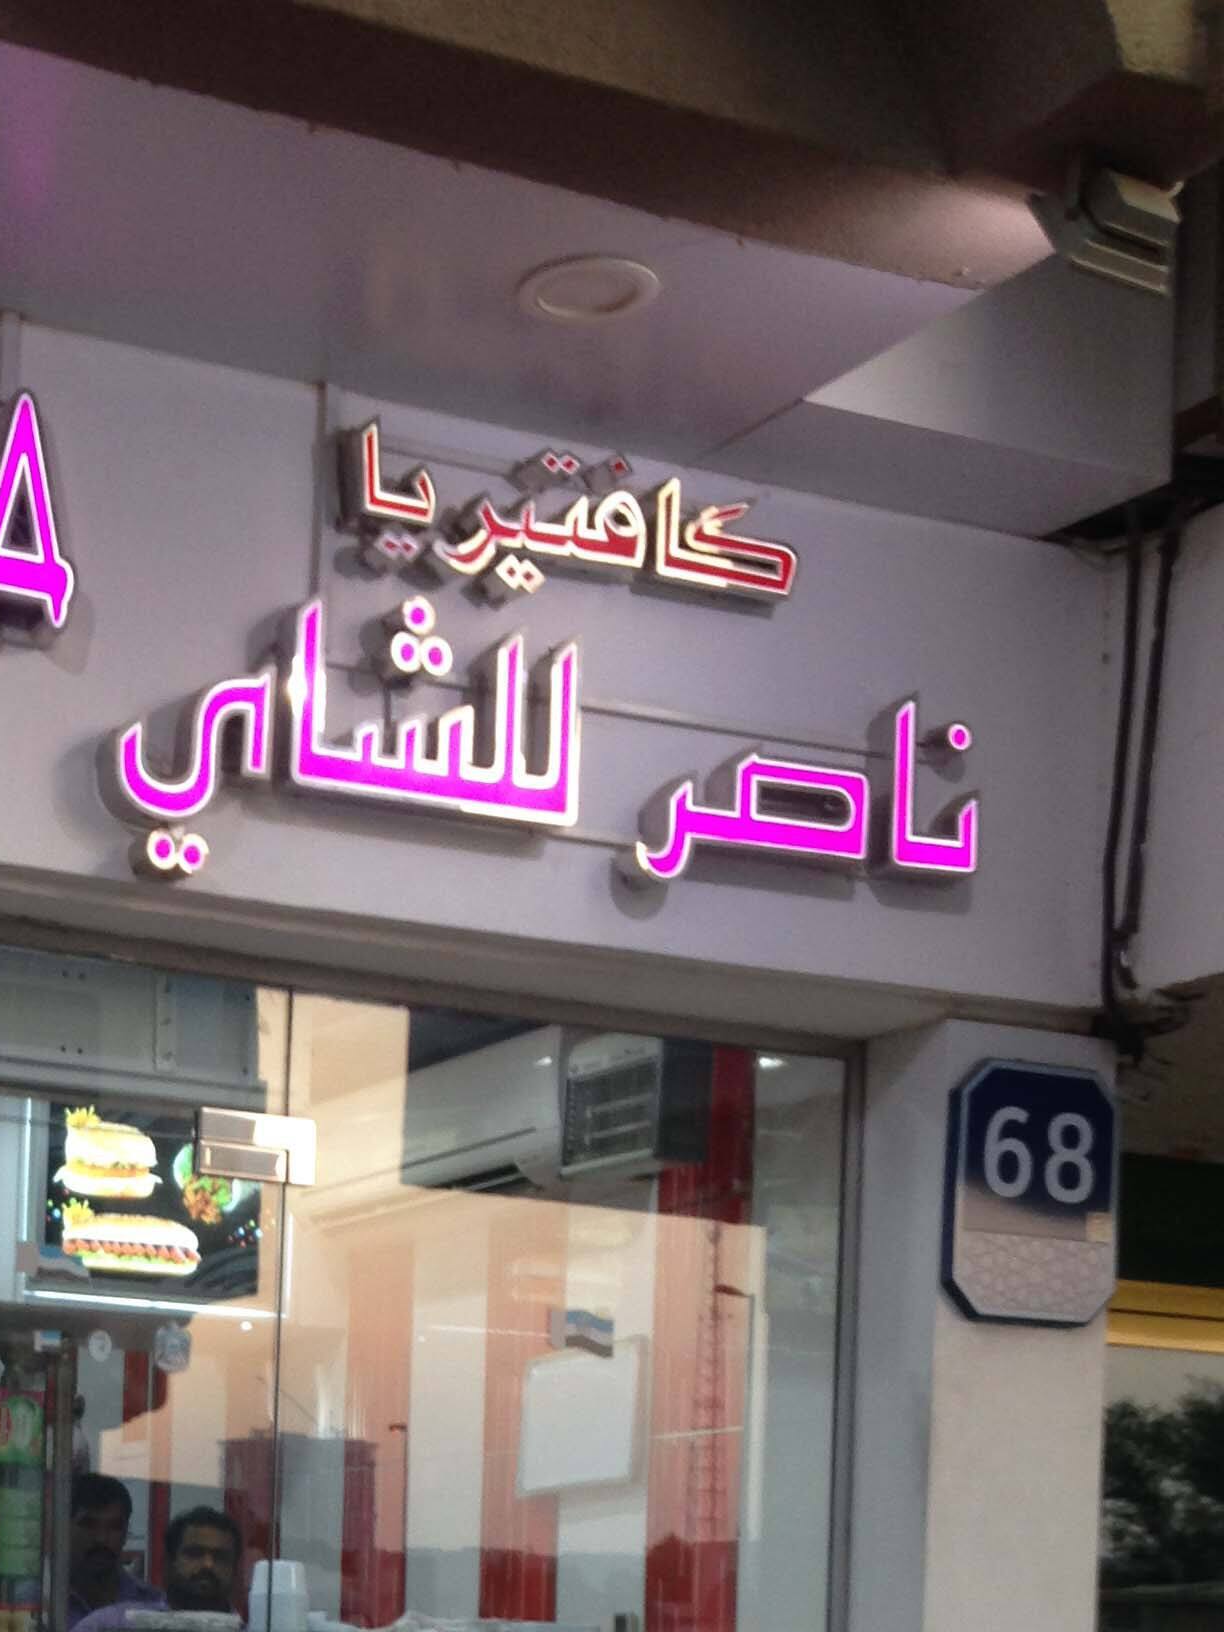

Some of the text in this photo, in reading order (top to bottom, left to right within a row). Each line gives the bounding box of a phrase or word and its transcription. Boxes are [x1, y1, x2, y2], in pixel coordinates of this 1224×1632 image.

[118, 594, 979, 879] ناصر للشاي
[984, 1106, 1094, 1203] 68
